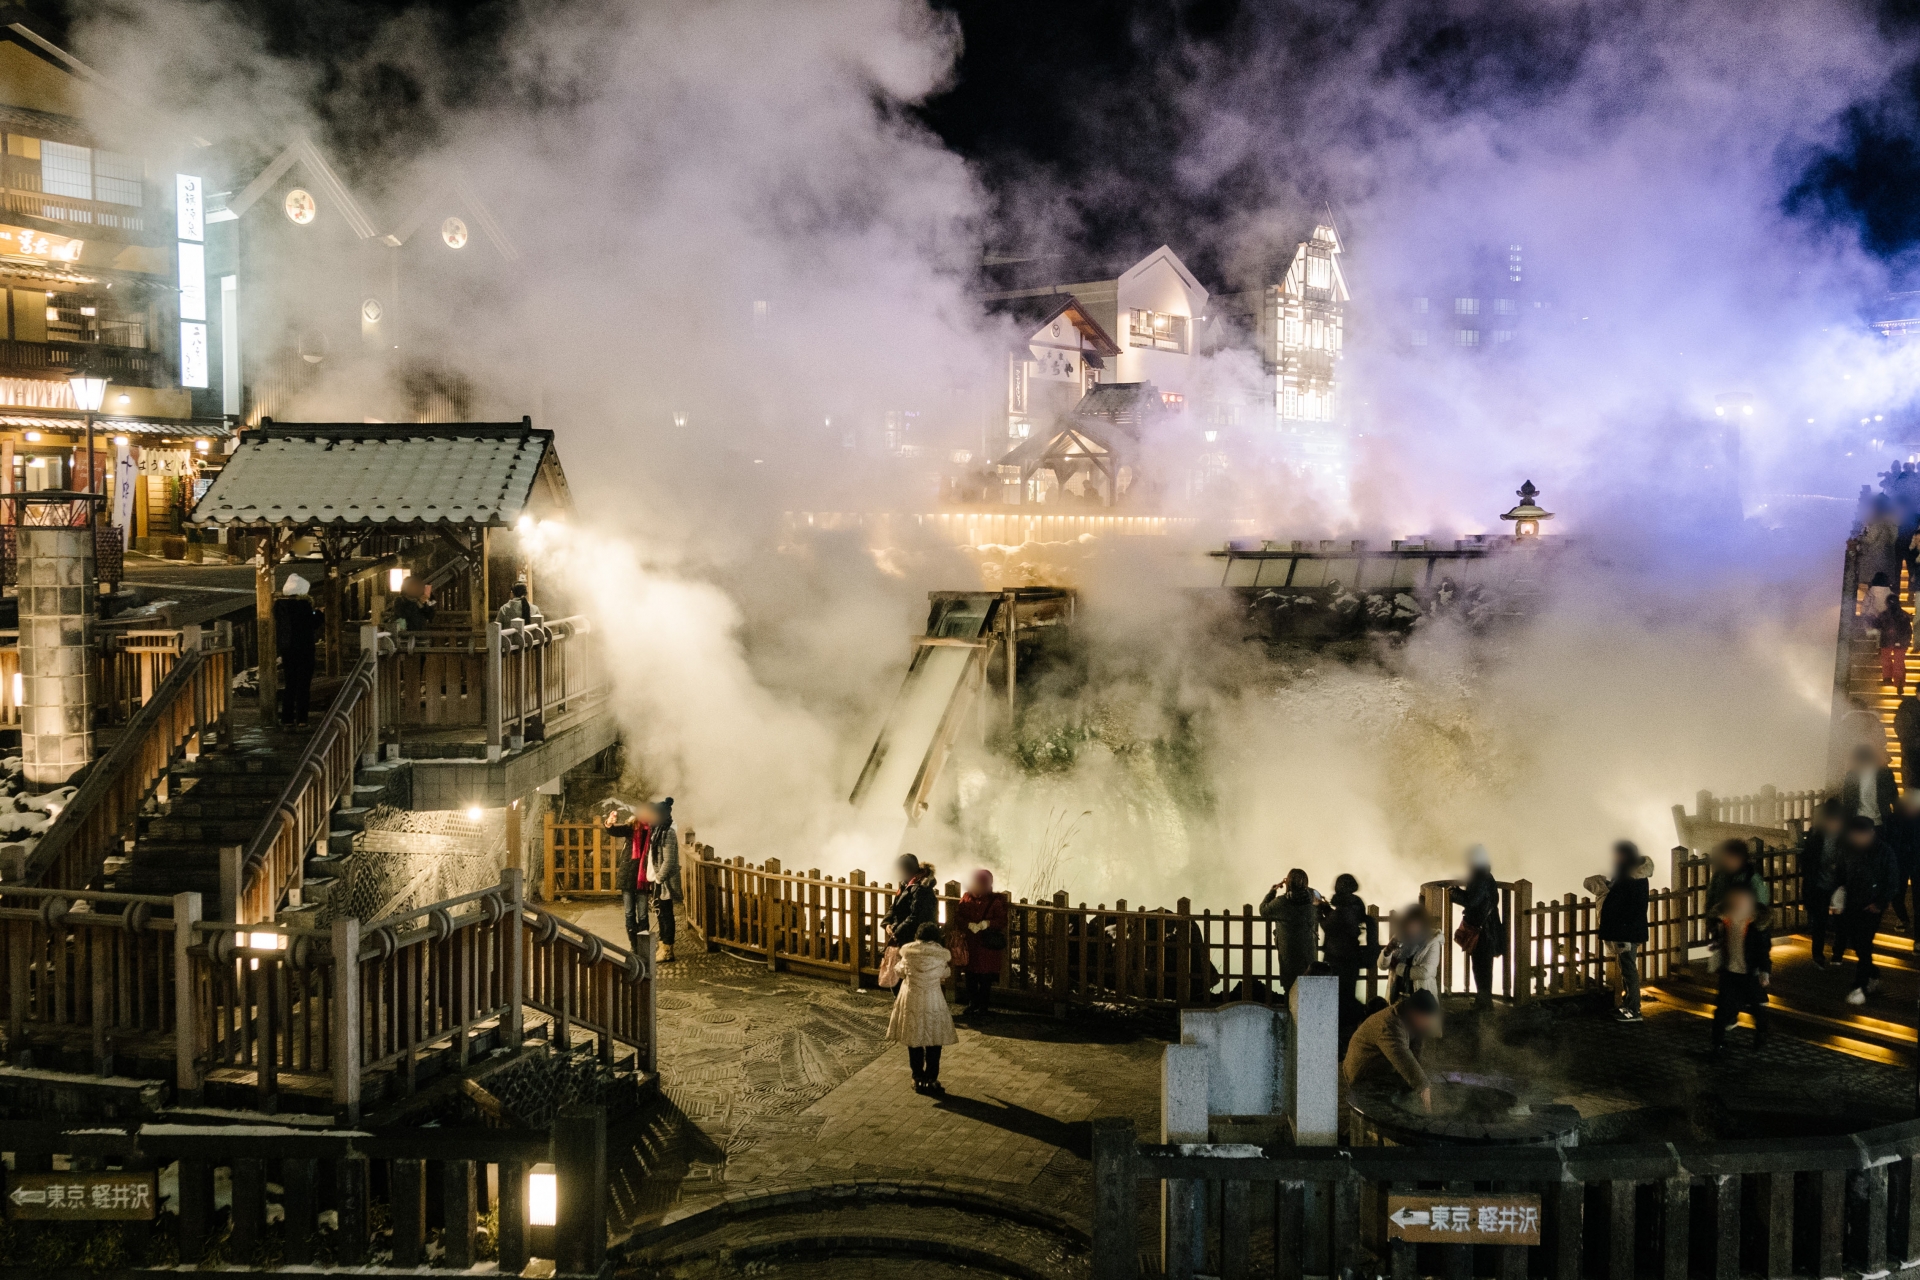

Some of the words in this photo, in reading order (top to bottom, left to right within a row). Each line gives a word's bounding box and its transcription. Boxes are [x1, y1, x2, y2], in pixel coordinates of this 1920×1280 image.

[47, 1184, 86, 1209] 東京
[91, 1184, 151, 1210] 軽井沢
[1430, 1205, 1471, 1232] 東京
[1477, 1205, 1539, 1233] 軽井沢
